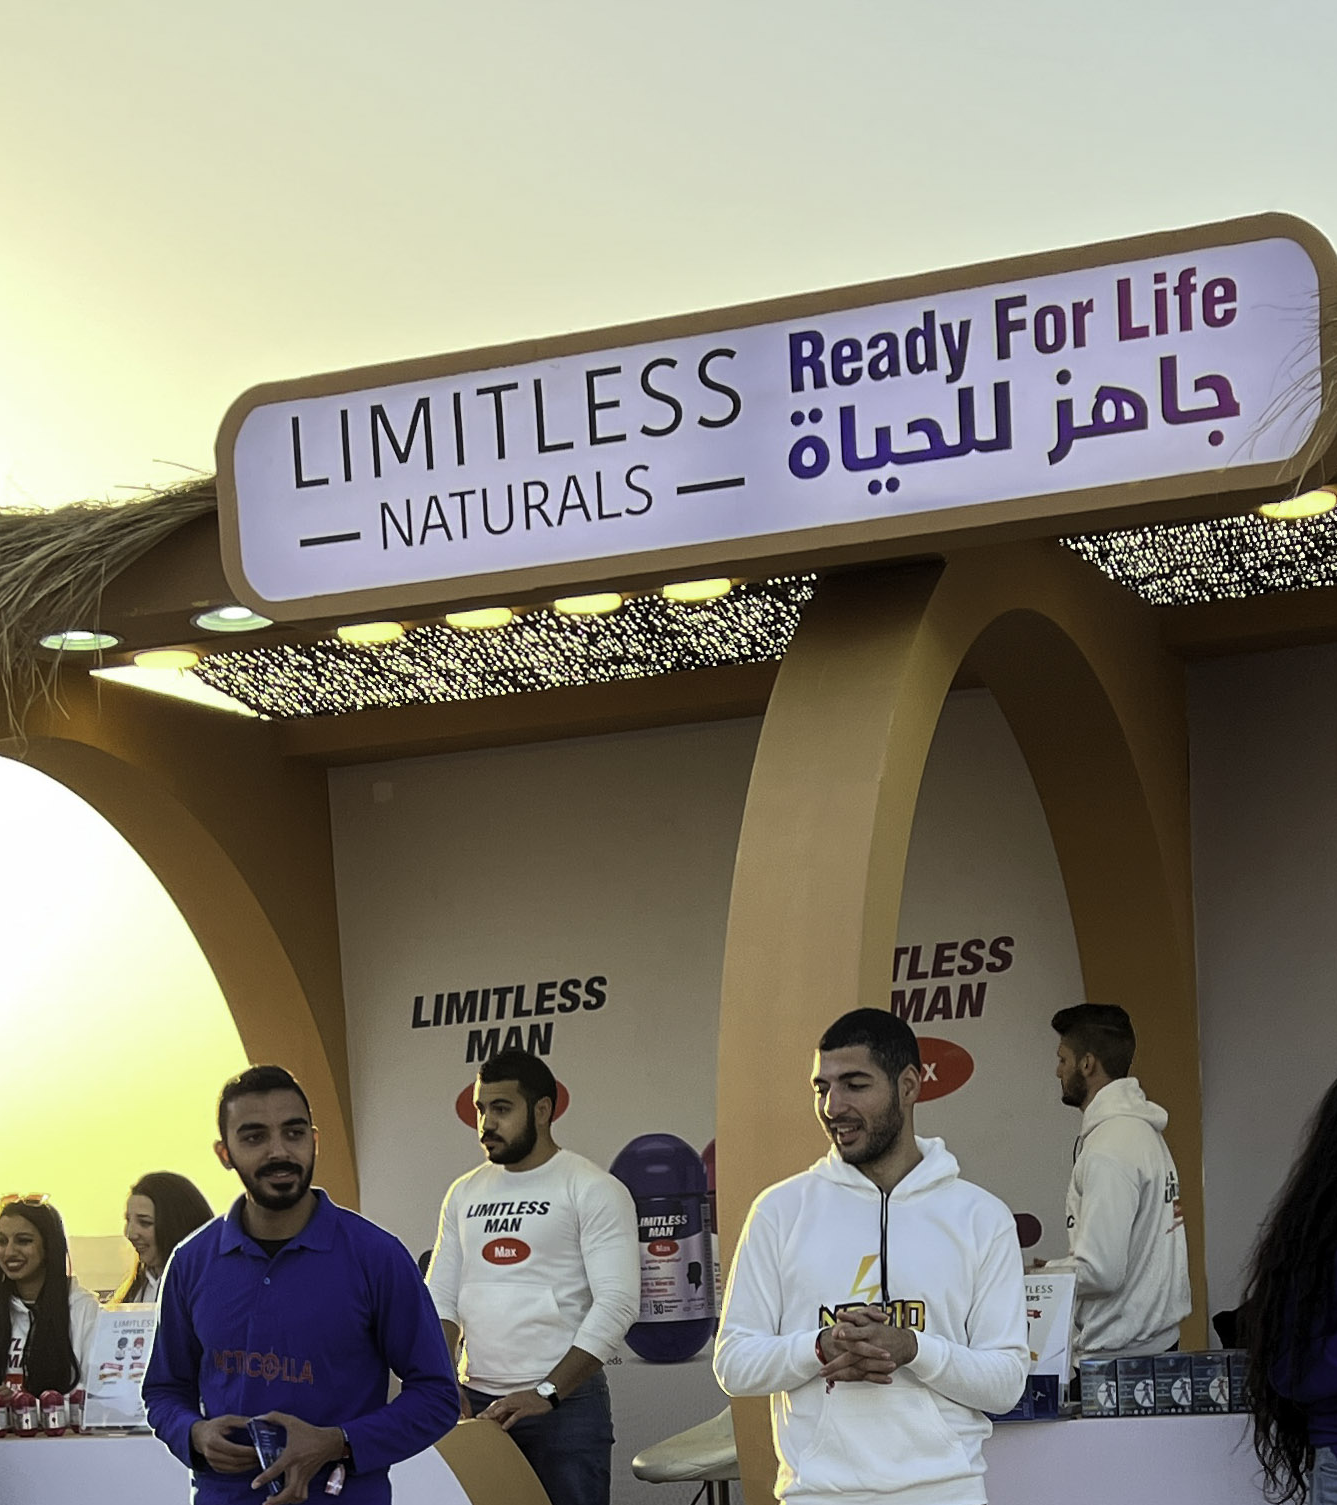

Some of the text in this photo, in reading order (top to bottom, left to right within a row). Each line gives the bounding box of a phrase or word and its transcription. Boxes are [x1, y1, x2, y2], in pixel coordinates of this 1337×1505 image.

[788, 267, 1238, 393] Ready For Life
[291, 347, 742, 489] LIMITLESS
[788, 354, 1241, 495] جاهز للحياة
[380, 464, 653, 550] NATURALS
[892, 936, 1015, 983] TLESS
[411, 975, 607, 1029] LIMITLESS
[890, 982, 987, 1023] MAN
[465, 1022, 554, 1063] MAN
[466, 1200, 551, 1219] LIMITLESS
[484, 1217, 522, 1233] MAN
[638, 1214, 688, 1228] IMITLESS
[494, 1246, 518, 1258] Max
[648, 1226, 674, 1238] MAN
[653, 1304, 665, 1315] 30
